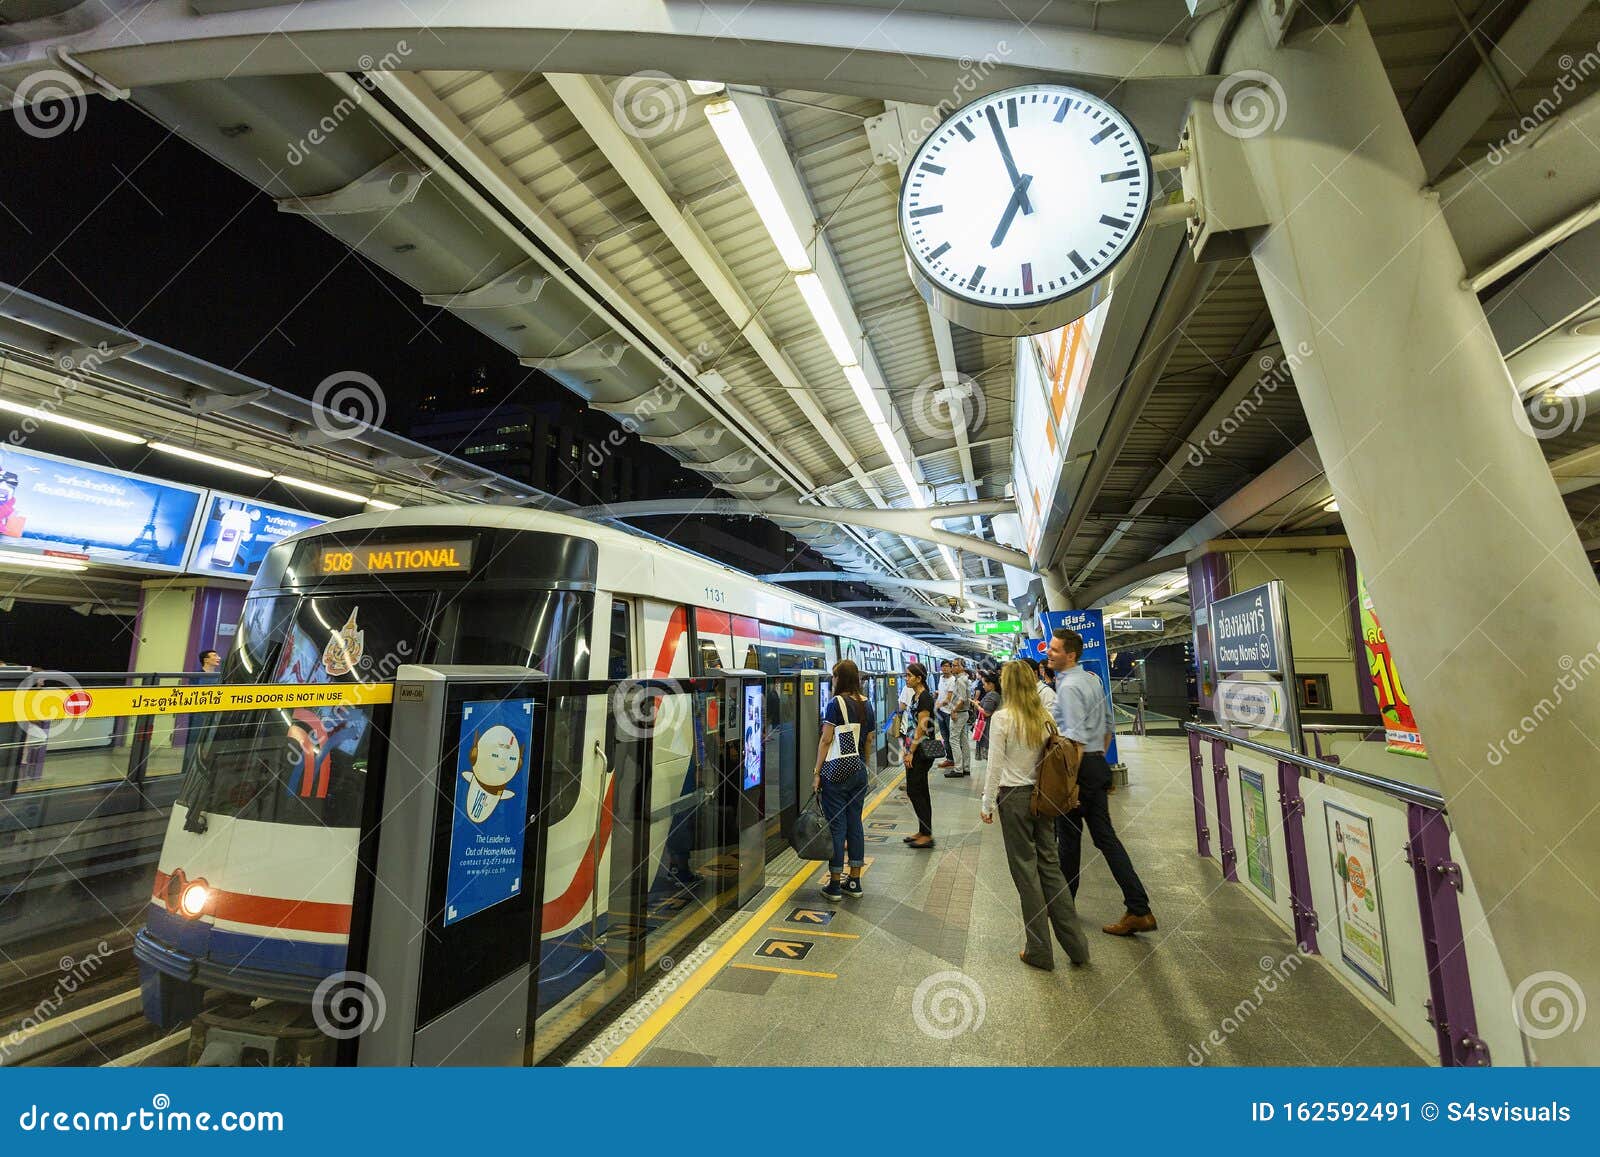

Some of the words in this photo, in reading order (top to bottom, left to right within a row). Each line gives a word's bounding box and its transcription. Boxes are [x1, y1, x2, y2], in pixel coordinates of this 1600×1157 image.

[323, 553, 353, 572] 508
[368, 549, 461, 570] NATIONAL
[704, 586, 726, 605] 1131
[1219, 595, 1265, 639] ช่องนนทรี
[1220, 646, 1239, 665] Chong
[1240, 643, 1259, 661] Nonsi
[1260, 643, 1270, 659] S3
[132, 688, 223, 711] ประตูนี้ไม่ได้ใช้
[231, 695, 254, 704] THIS
[255, 693, 284, 704] DOOR
[286, 693, 295, 702] IS
[296, 693, 315, 702] NOT
[316, 693, 325, 701] IN
[326, 692, 343, 701] USE
[476, 834, 486, 843] The
[486, 834, 505, 843] Leader
[505, 834, 511, 843] in
[465, 848, 476, 856] Out
[477, 847, 483, 856] of
[484, 848, 500, 856] Home
[500, 847, 516, 856] Media
